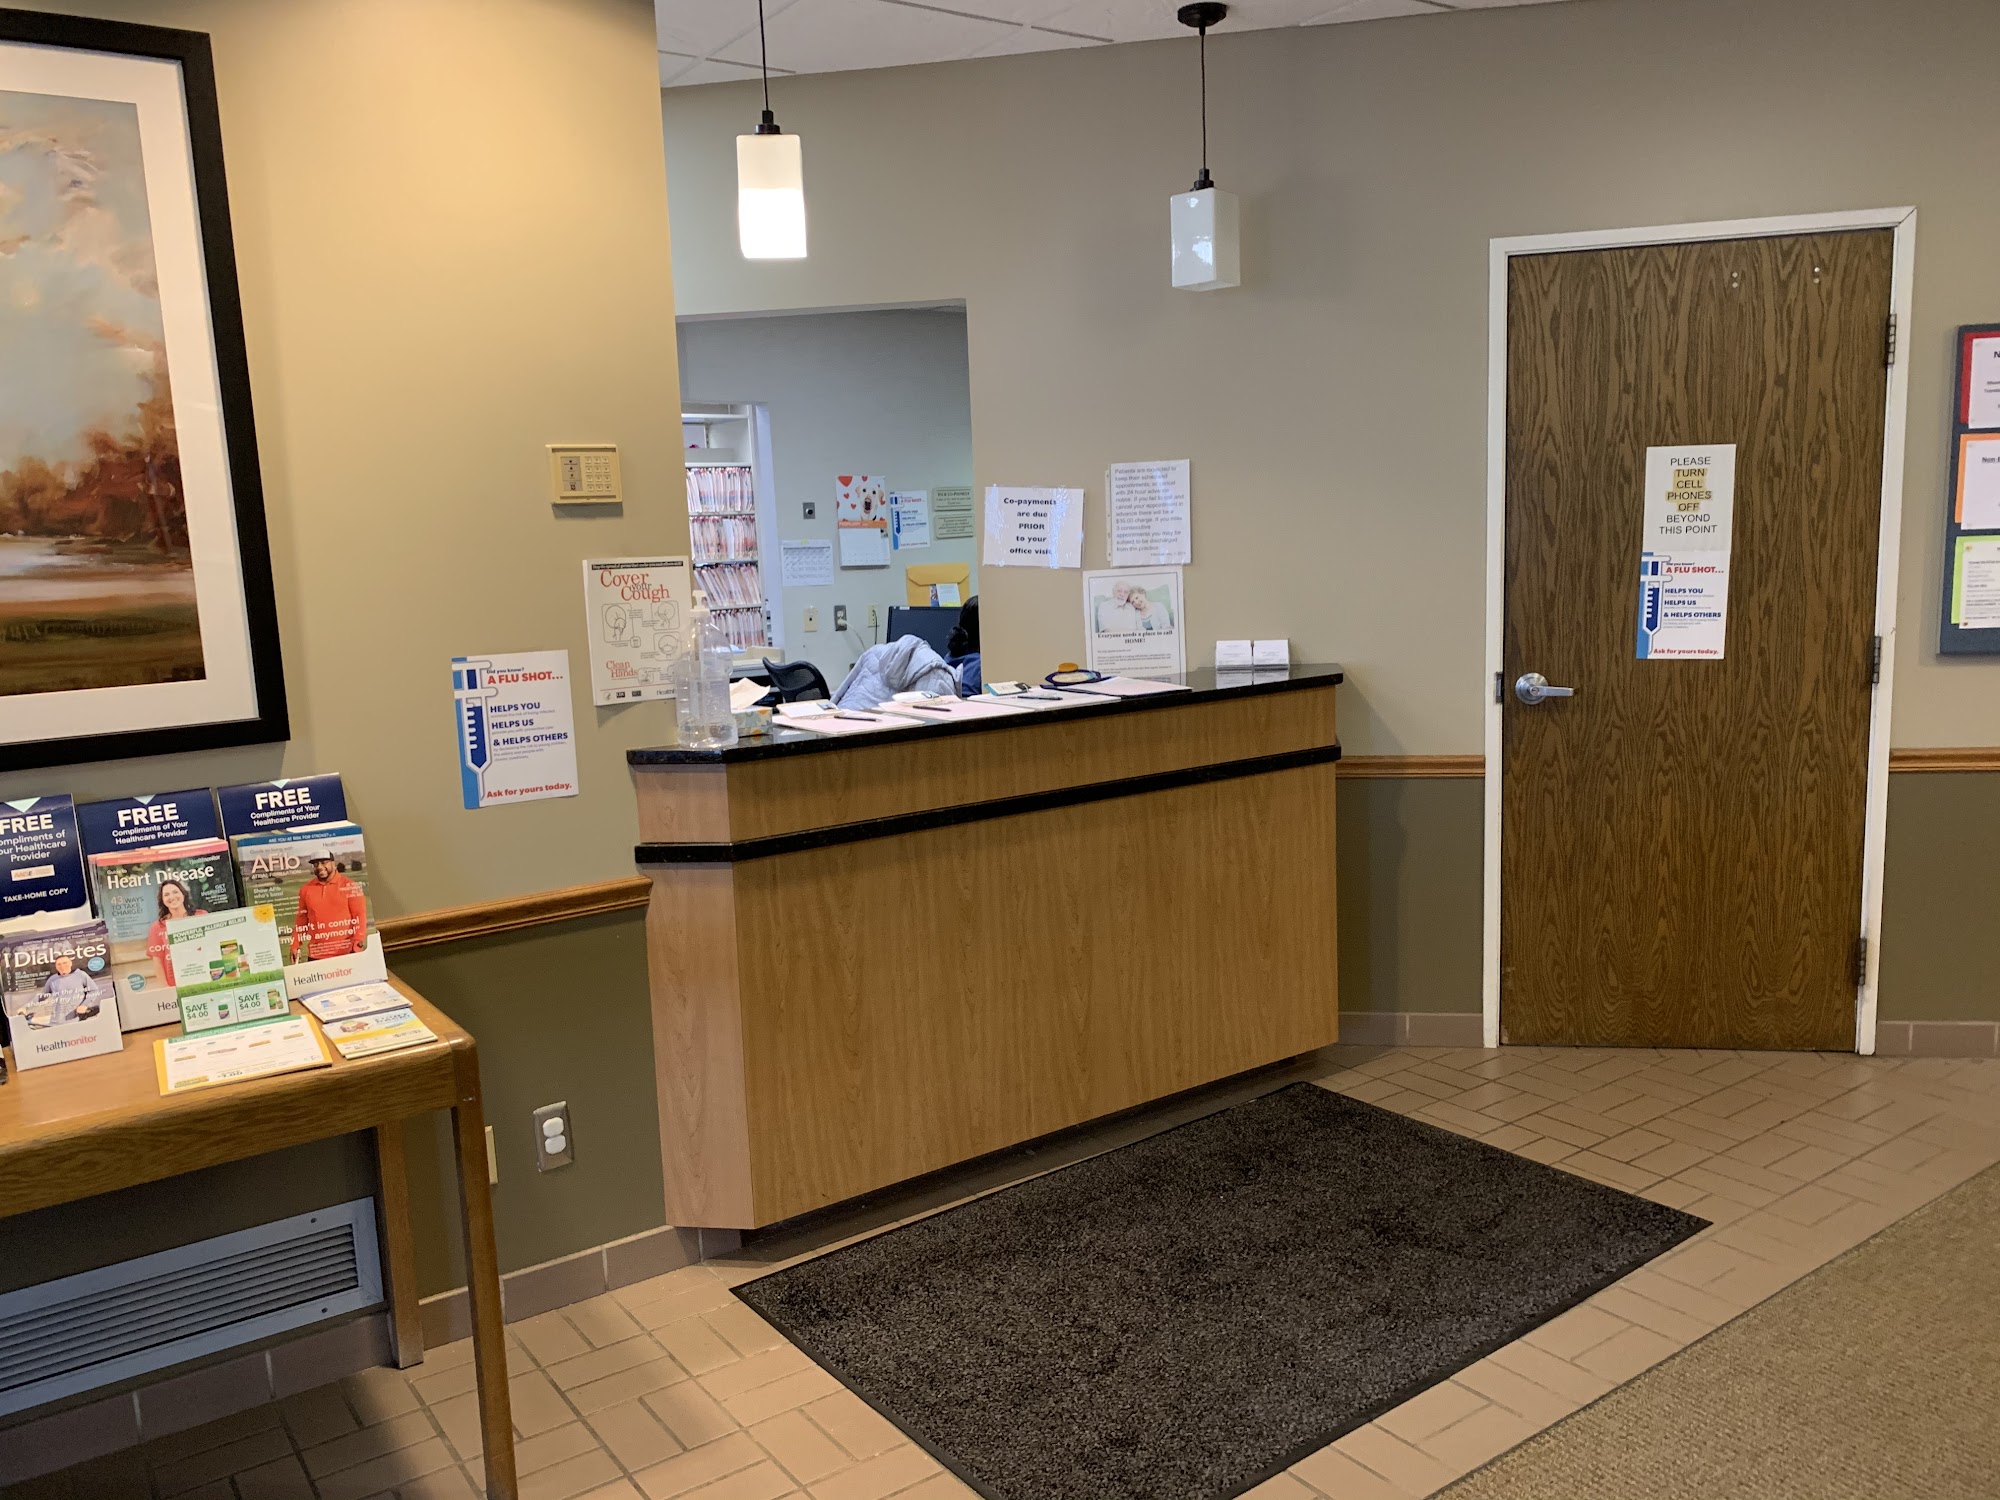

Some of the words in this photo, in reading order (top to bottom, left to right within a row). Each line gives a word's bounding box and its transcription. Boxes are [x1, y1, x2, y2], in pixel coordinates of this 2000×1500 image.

[1670, 456, 1711, 466] PLEASE
[1675, 468, 1705, 477] TURN
[1676, 480, 1703, 489] CELL
[1667, 491, 1712, 500] PHONES
[1003, 497, 1057, 507] Co-payments
[1678, 503, 1700, 512] OFF
[1666, 513, 1710, 523] BEYOND
[1659, 526, 1682, 534] THIS
[1685, 524, 1718, 534] POINT
[1028, 536, 1047, 544] your
[1009, 547, 1032, 555] office
[600, 569, 649, 588] Cover
[621, 584, 670, 603] Cough
[606, 660, 631, 670] Clean
[611, 667, 638, 678] Hands
[488, 675, 497, 685] A
[498, 673, 519, 684] FLU
[490, 703, 519, 713] HELPS
[520, 702, 541, 710] YOU
[491, 720, 520, 730] HELPS
[522, 718, 534, 727] US
[493, 739, 500, 747] &
[502, 735, 531, 746] HELPS
[532, 732, 569, 742] OTHERS
[486, 789, 503, 798] Ask
[504, 788, 518, 797] for
[519, 786, 544, 797] yours
[545, 782, 573, 792] today.
[255, 786, 312, 811] FREE
[117, 802, 180, 828] FREE
[250, 808, 296, 820] Compliments
[296, 806, 304, 814] of
[303, 804, 321, 812] Your
[0, 813, 54, 836] FREE
[253, 816, 291, 827] Healthcare
[291, 812, 320, 822] Provider
[112, 825, 161, 837] Compliments
[162, 823, 171, 831] of
[172, 820, 189, 829] Your
[0, 832, 54, 847] ompliments
[56, 829, 66, 840] of
[115, 833, 156, 845] Healthcare
[157, 828, 188, 839] Provider
[0, 846, 14, 856] our
[16, 839, 67, 853] Healthcare
[10, 851, 51, 863] Provider
[252, 852, 301, 874] AFib
[107, 872, 152, 890] Heart
[155, 865, 215, 885] Disease
[3, 890, 48, 903] TAKE-HOME
[49, 887, 69, 897] COPY
[112, 908, 144, 917] CHARGE!
[124, 903, 139, 911] TAKE
[278, 926, 293, 936] Fib
[295, 922, 315, 932] isn't
[317, 921, 326, 930] in
[328, 916, 360, 929] control
[281, 935, 295, 946] my
[297, 931, 312, 943] life
[14, 943, 107, 968] Diabetes
[61, 988, 74, 996] the
[238, 992, 260, 1004] SAVE
[26, 998, 51, 1008] shape
[60, 996, 72, 1004] my
[185, 1002, 208, 1014] SAVE
[239, 1001, 261, 1010] $4.00
[186, 1010, 209, 1020] $4.00
